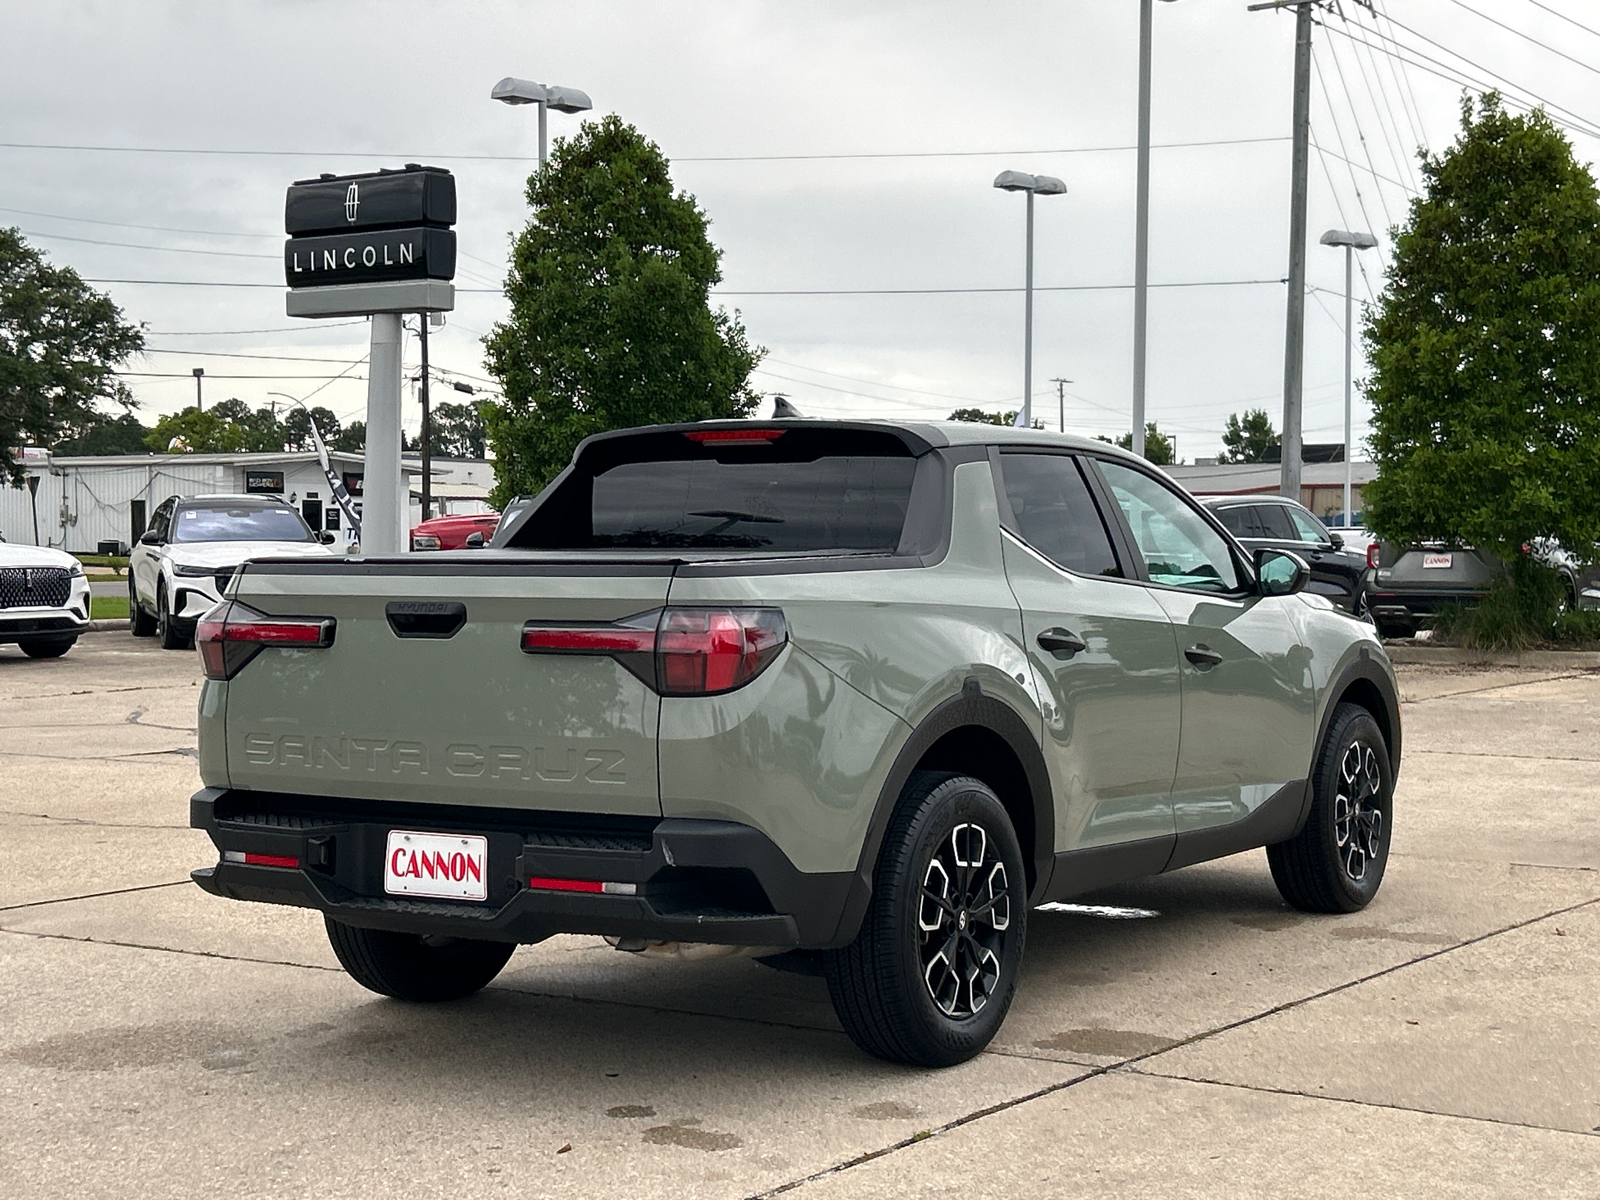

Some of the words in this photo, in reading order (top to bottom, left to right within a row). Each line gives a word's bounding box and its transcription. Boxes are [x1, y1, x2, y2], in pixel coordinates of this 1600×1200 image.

[293, 243, 413, 272] LINCOLN
[398, 603, 449, 613] HYUNDAI
[245, 732, 429, 775] SANTA
[446, 743, 627, 784] CRUZ
[391, 848, 482, 883] CANNON
